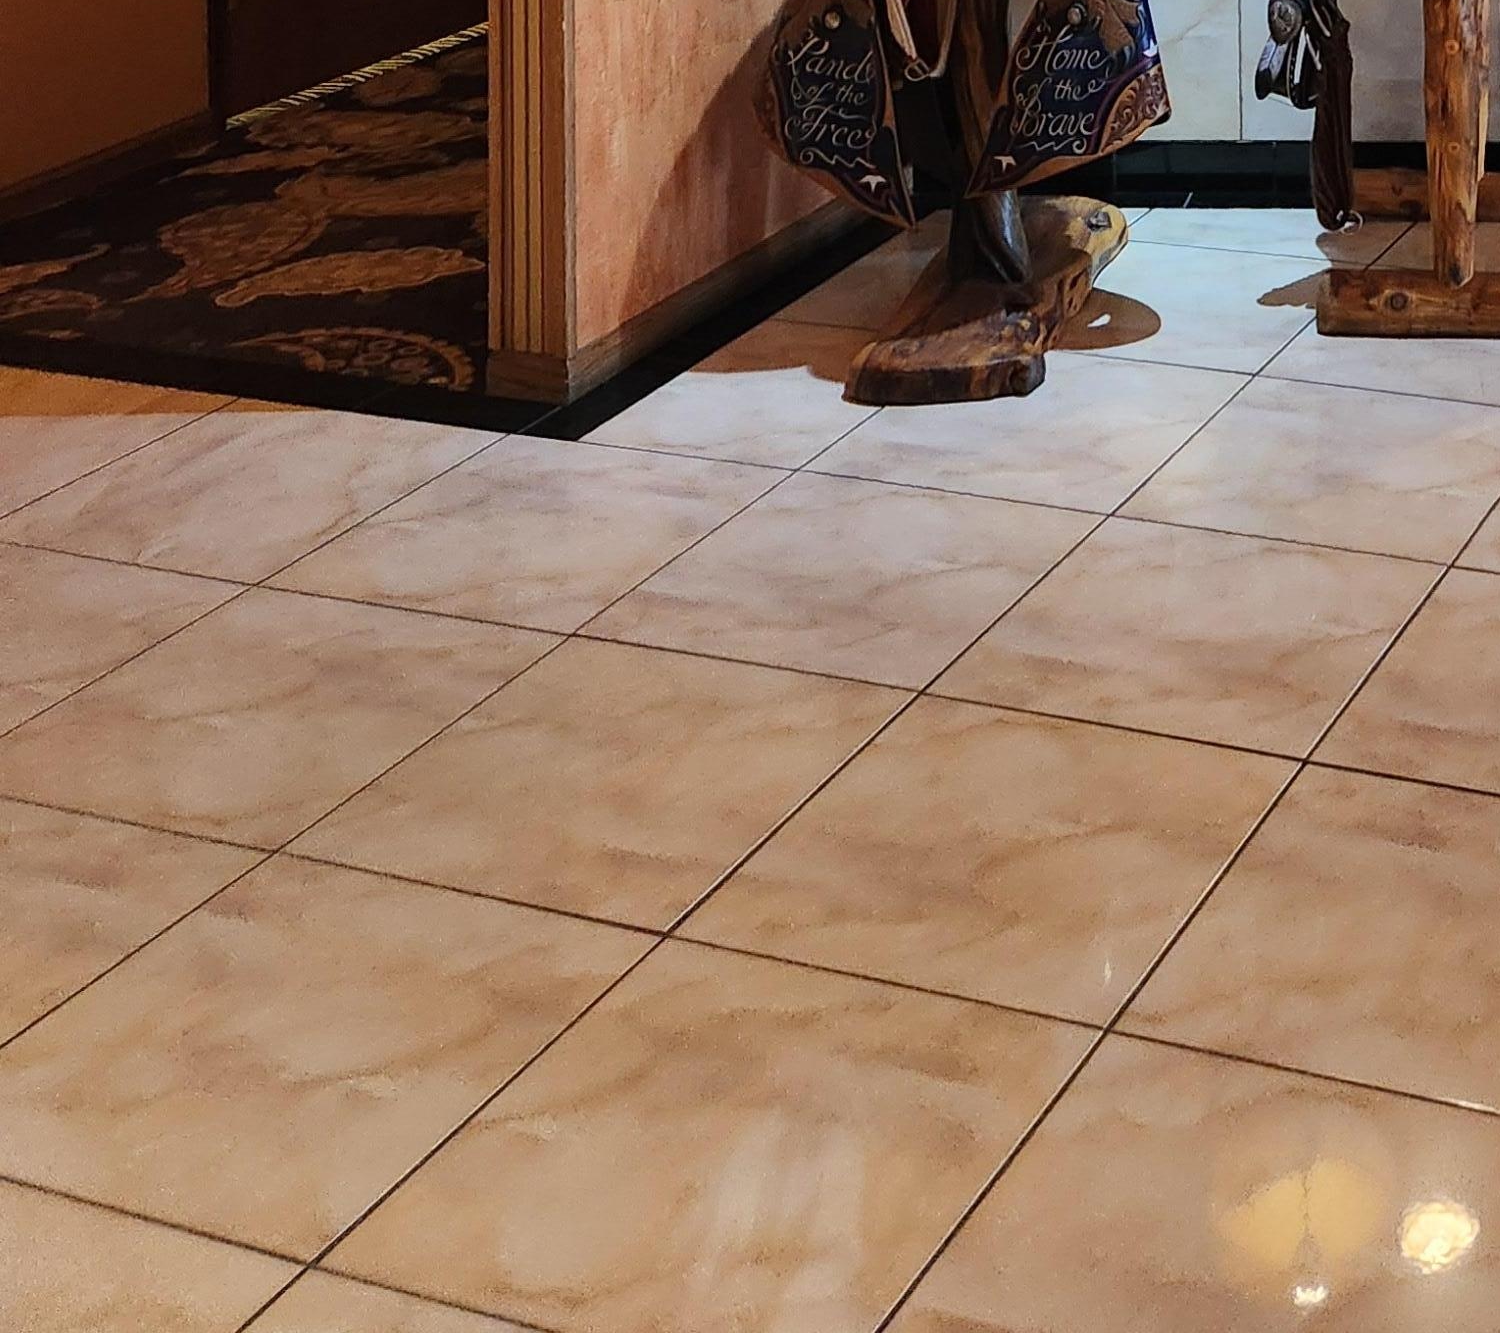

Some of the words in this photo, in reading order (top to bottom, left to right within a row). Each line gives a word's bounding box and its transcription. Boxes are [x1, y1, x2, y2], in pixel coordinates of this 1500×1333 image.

[788, 36, 874, 84] Land
[1016, 24, 1112, 76] Home
[836, 84, 866, 106] the
[785, 104, 877, 149] Free
[1010, 101, 1096, 137] Brave
